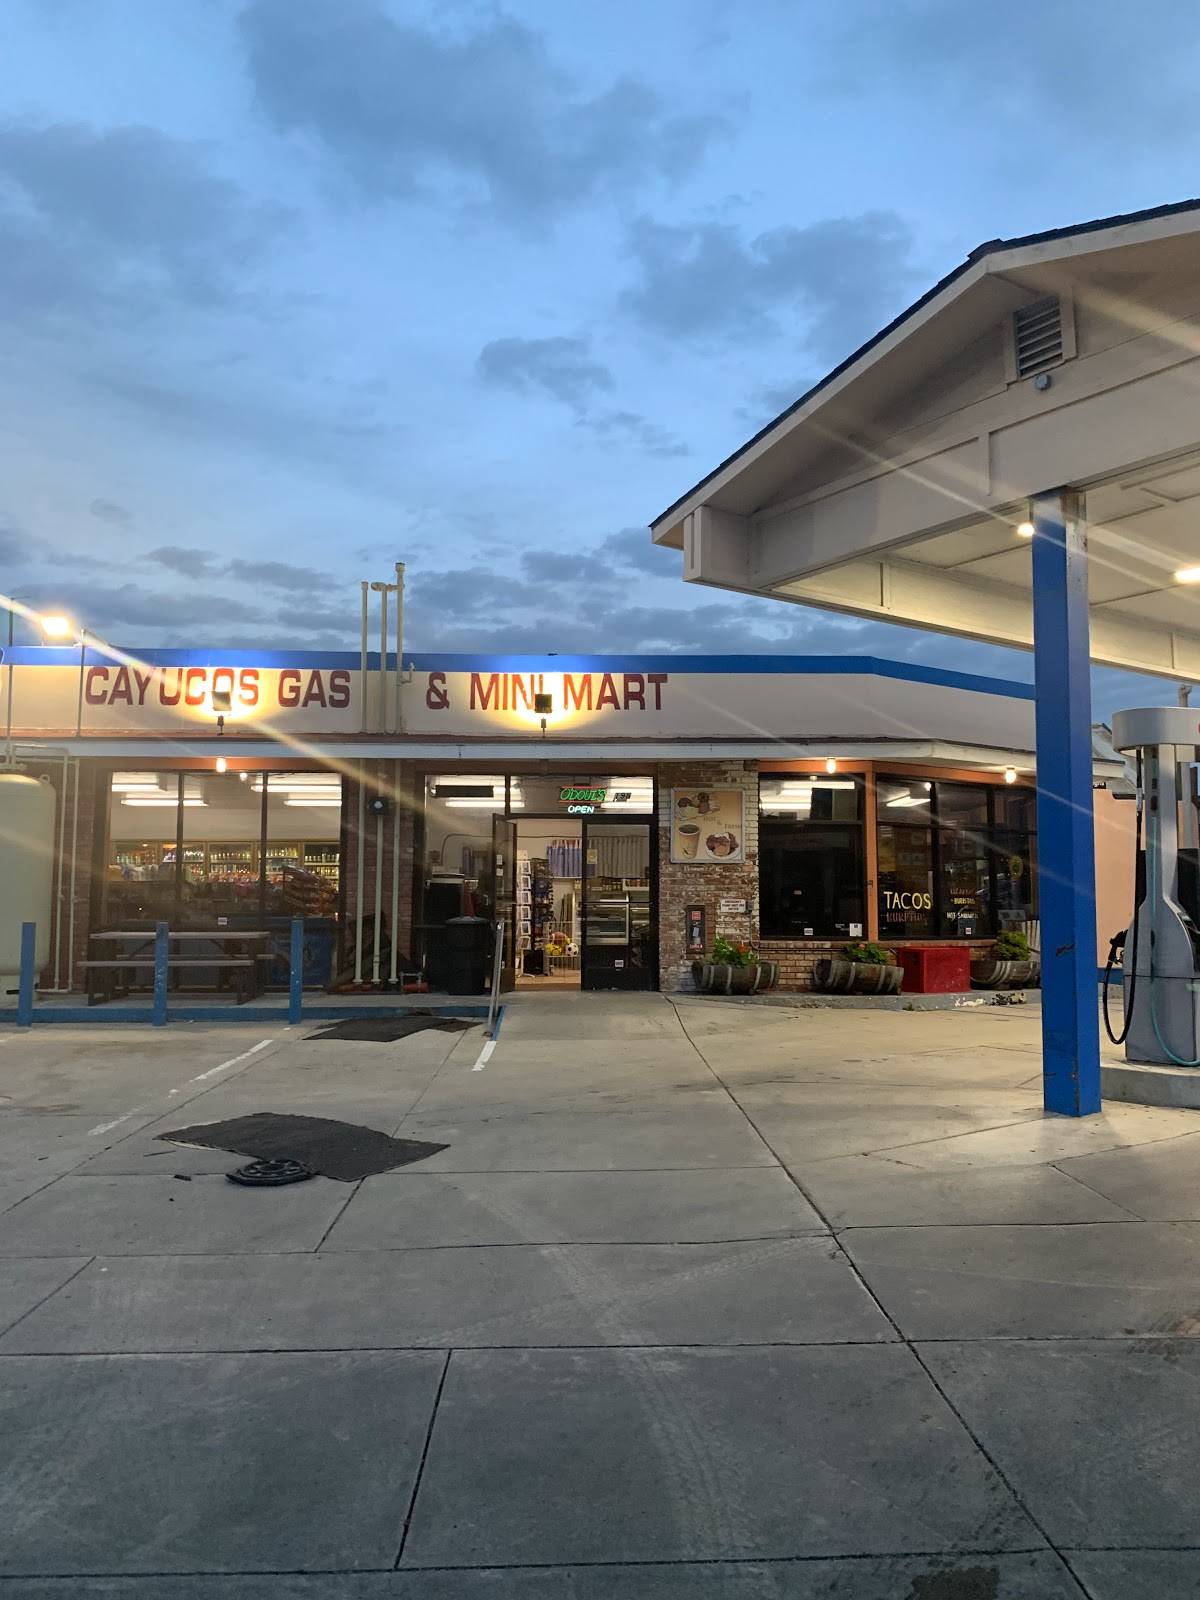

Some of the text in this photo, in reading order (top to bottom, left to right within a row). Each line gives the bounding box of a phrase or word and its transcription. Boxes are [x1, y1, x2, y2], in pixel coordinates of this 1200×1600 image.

[85, 666, 668, 711] CAYUCOS GAS & MINI MART
[567, 804, 595, 814] OPEN
[883, 891, 932, 910] TACOS
